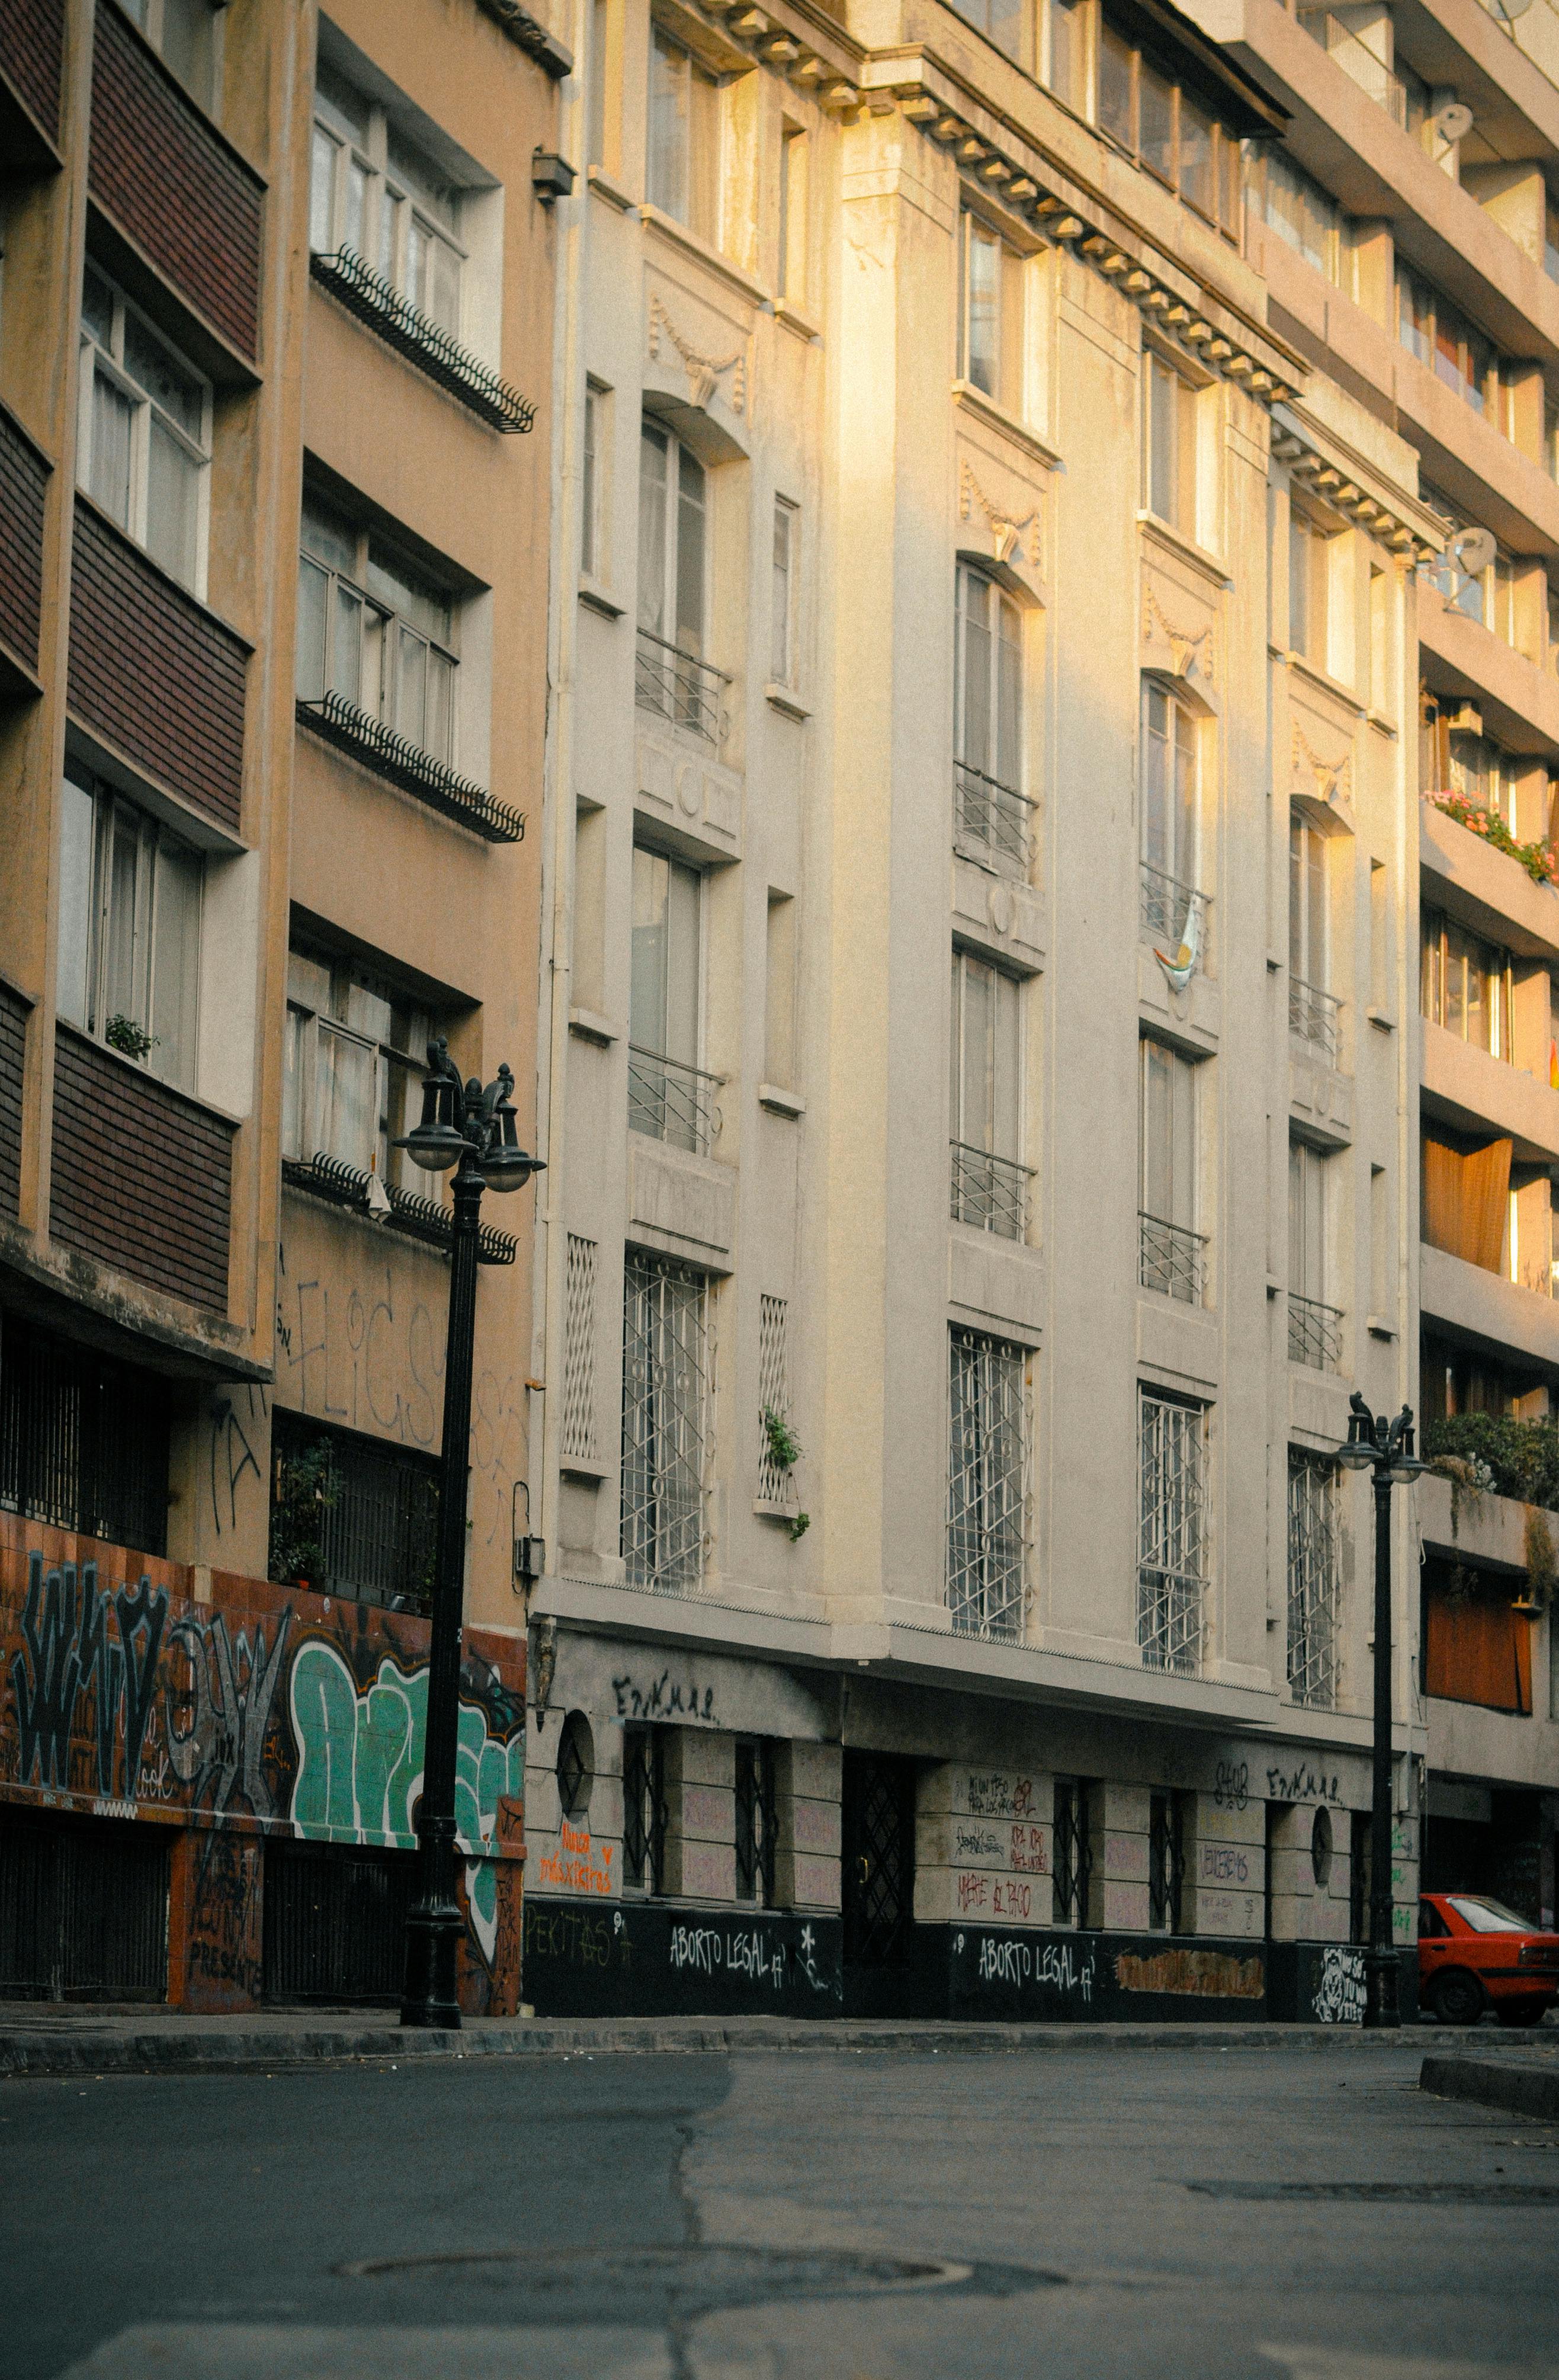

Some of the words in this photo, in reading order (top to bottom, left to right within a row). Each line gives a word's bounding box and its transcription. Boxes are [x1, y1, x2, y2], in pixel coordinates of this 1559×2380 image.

[670, 1926, 721, 1975] ABORTO
[727, 1931, 769, 1979] LEGAL
[979, 1937, 1031, 1988] ABORTO
[1037, 1945, 1078, 1991] LEGAL
